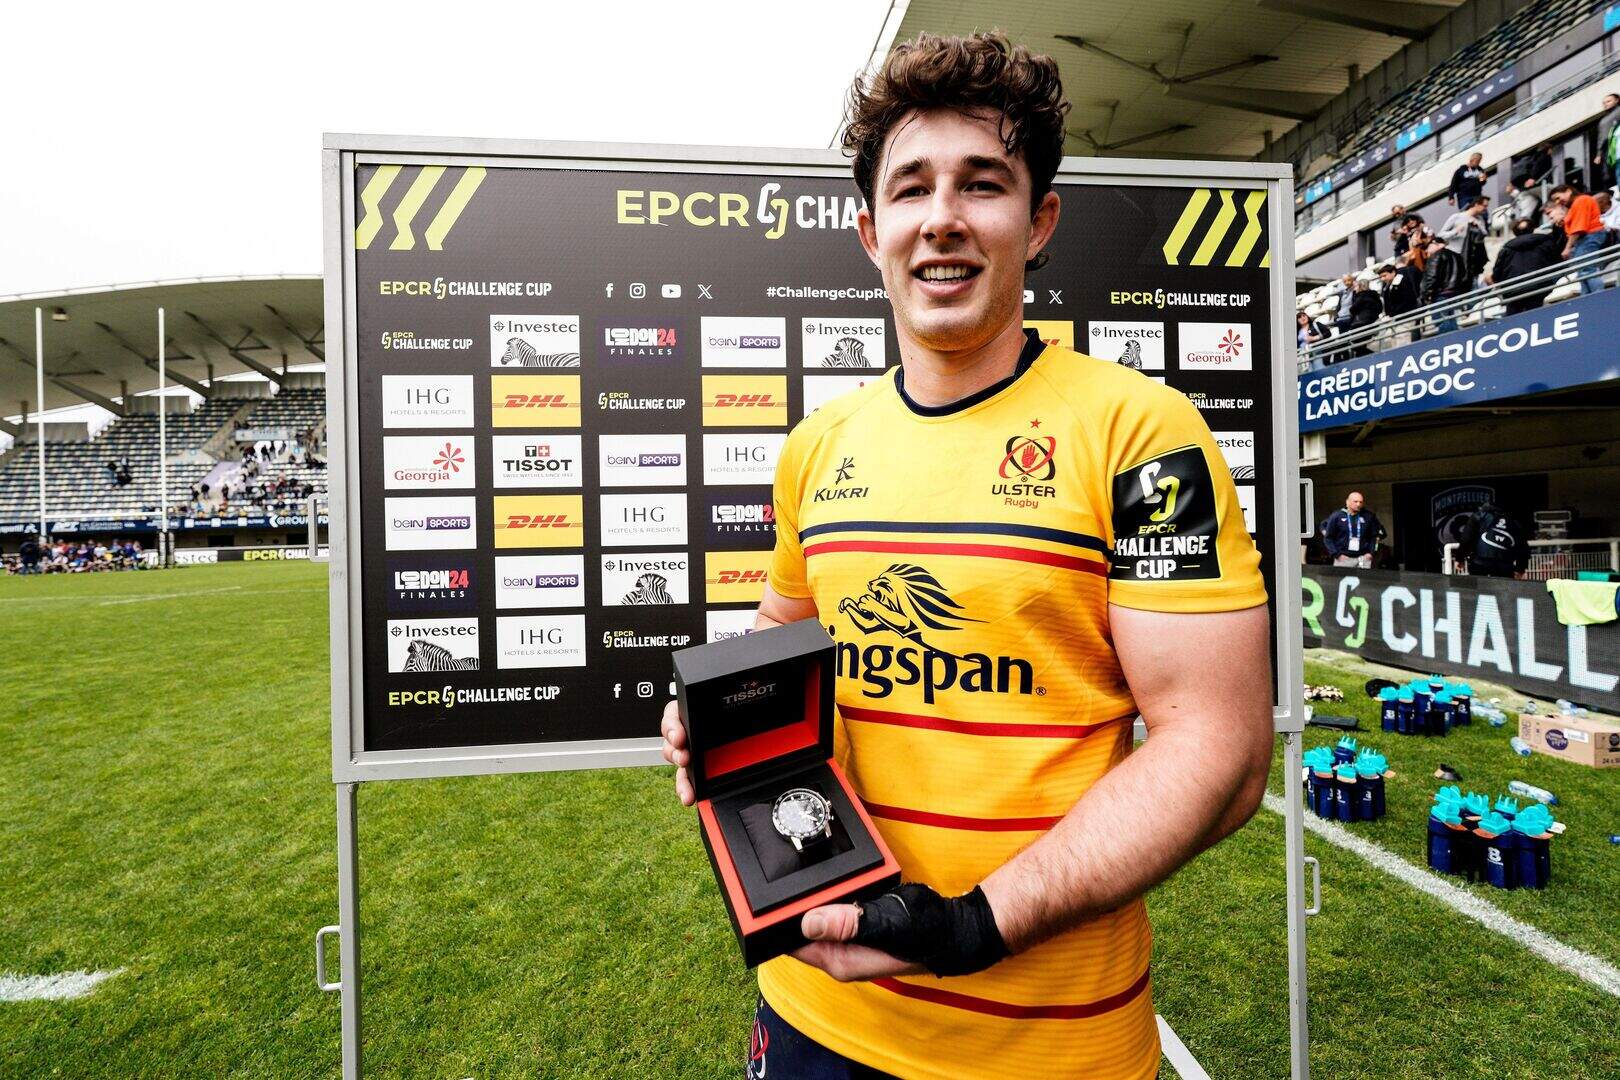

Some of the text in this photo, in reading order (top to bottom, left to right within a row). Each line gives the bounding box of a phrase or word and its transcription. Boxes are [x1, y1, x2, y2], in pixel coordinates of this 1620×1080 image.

[617, 189, 868, 229] EPCR CHA
[380, 281, 552, 296] EPCR CHALLENGE CUP
[766, 287, 890, 300] #ChallengeCupRu
[1110, 292, 1250, 307] EPCR CHALLENGE CUP
[508, 321, 577, 333] Investec
[819, 323, 882, 335] Investec
[1104, 326, 1162, 338] Investec
[392, 339, 473, 350] CHALLENGE CUP
[742, 337, 778, 347] SPORTS
[1187, 353, 1232, 364] Georgia
[1306, 312, 1579, 398] CRÉDIT AGRICOLE
[407, 388, 450, 405] IHG
[1305, 368, 1475, 421] LANGUEDOC
[504, 395, 568, 408] DHL
[609, 398, 686, 410] CHALLENGE CUP
[714, 395, 776, 408] DHL
[1237, 399, 1253, 409] CUP
[1216, 438, 1252, 448] estec
[642, 456, 679, 464] SPORTS
[726, 447, 766, 462] IHG
[503, 459, 572, 471] TISSOT
[394, 470, 450, 483] Georgia
[814, 487, 869, 503] KUKRI
[992, 484, 1056, 498] ULSTER
[1004, 497, 1039, 509] Rugby
[624, 507, 665, 523] IHG
[429, 518, 468, 528] SPORTS
[507, 515, 571, 529] DHL
[1137, 523, 1176, 535] EPCR
[243, 549, 278, 560] EPCR
[619, 560, 686, 572] Investec
[1136, 559, 1177, 579] CUP
[539, 576, 576, 586] SPORTS
[401, 590, 465, 599] FINALES
[406, 625, 476, 637] Investec
[520, 628, 562, 645] IHG
[614, 635, 690, 648] CHALLENGE CUP
[388, 686, 560, 706] EPCR CHALLENGE CUP
[722, 683, 776, 704] TISSOT
